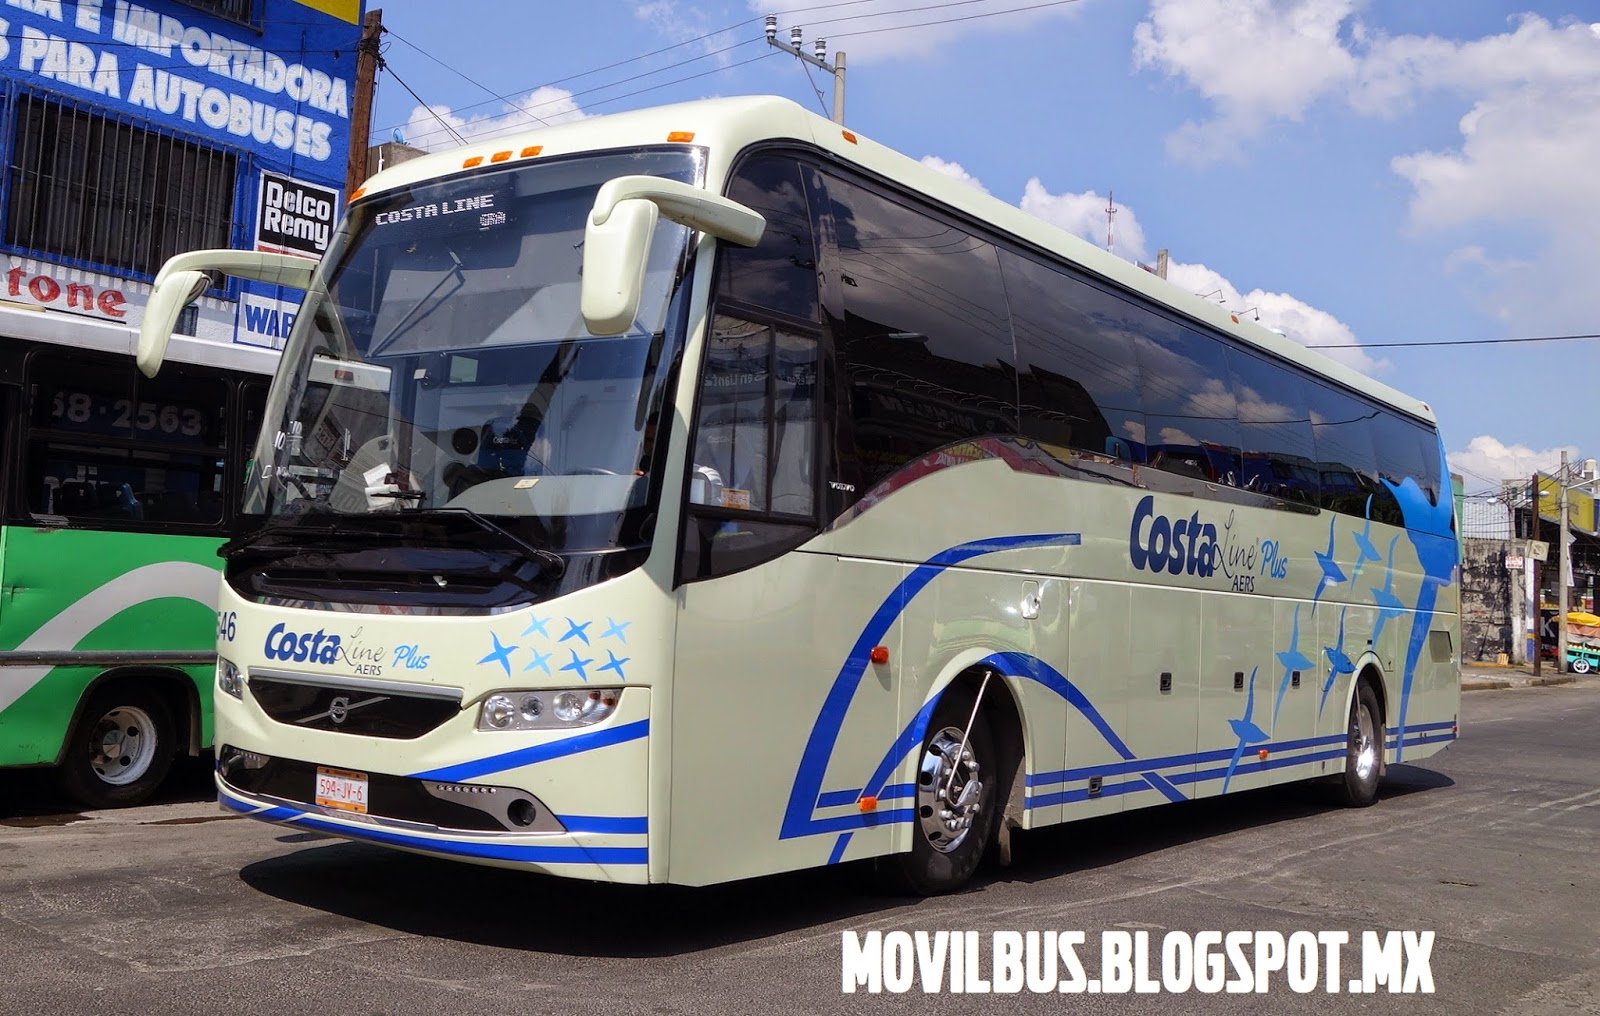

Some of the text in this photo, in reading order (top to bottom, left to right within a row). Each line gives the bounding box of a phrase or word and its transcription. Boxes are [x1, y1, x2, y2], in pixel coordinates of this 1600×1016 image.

[112, 0, 349, 119] IMPORTADORA
[19, 25, 120, 99] PARA
[127, 63, 332, 161] AUTOBUSES
[267, 181, 331, 221] Delco
[375, 194, 494, 226] COSTA LINE
[264, 206, 329, 250] Remy
[7, 266, 127, 317] tone
[1130, 495, 1288, 579] Costa Line Plus
[1231, 574, 1255, 592] AERS
[264, 623, 431, 670] Costa Line Plus
[354, 663, 382, 676] AERS
[320, 778, 363, 801] 594-JV-6
